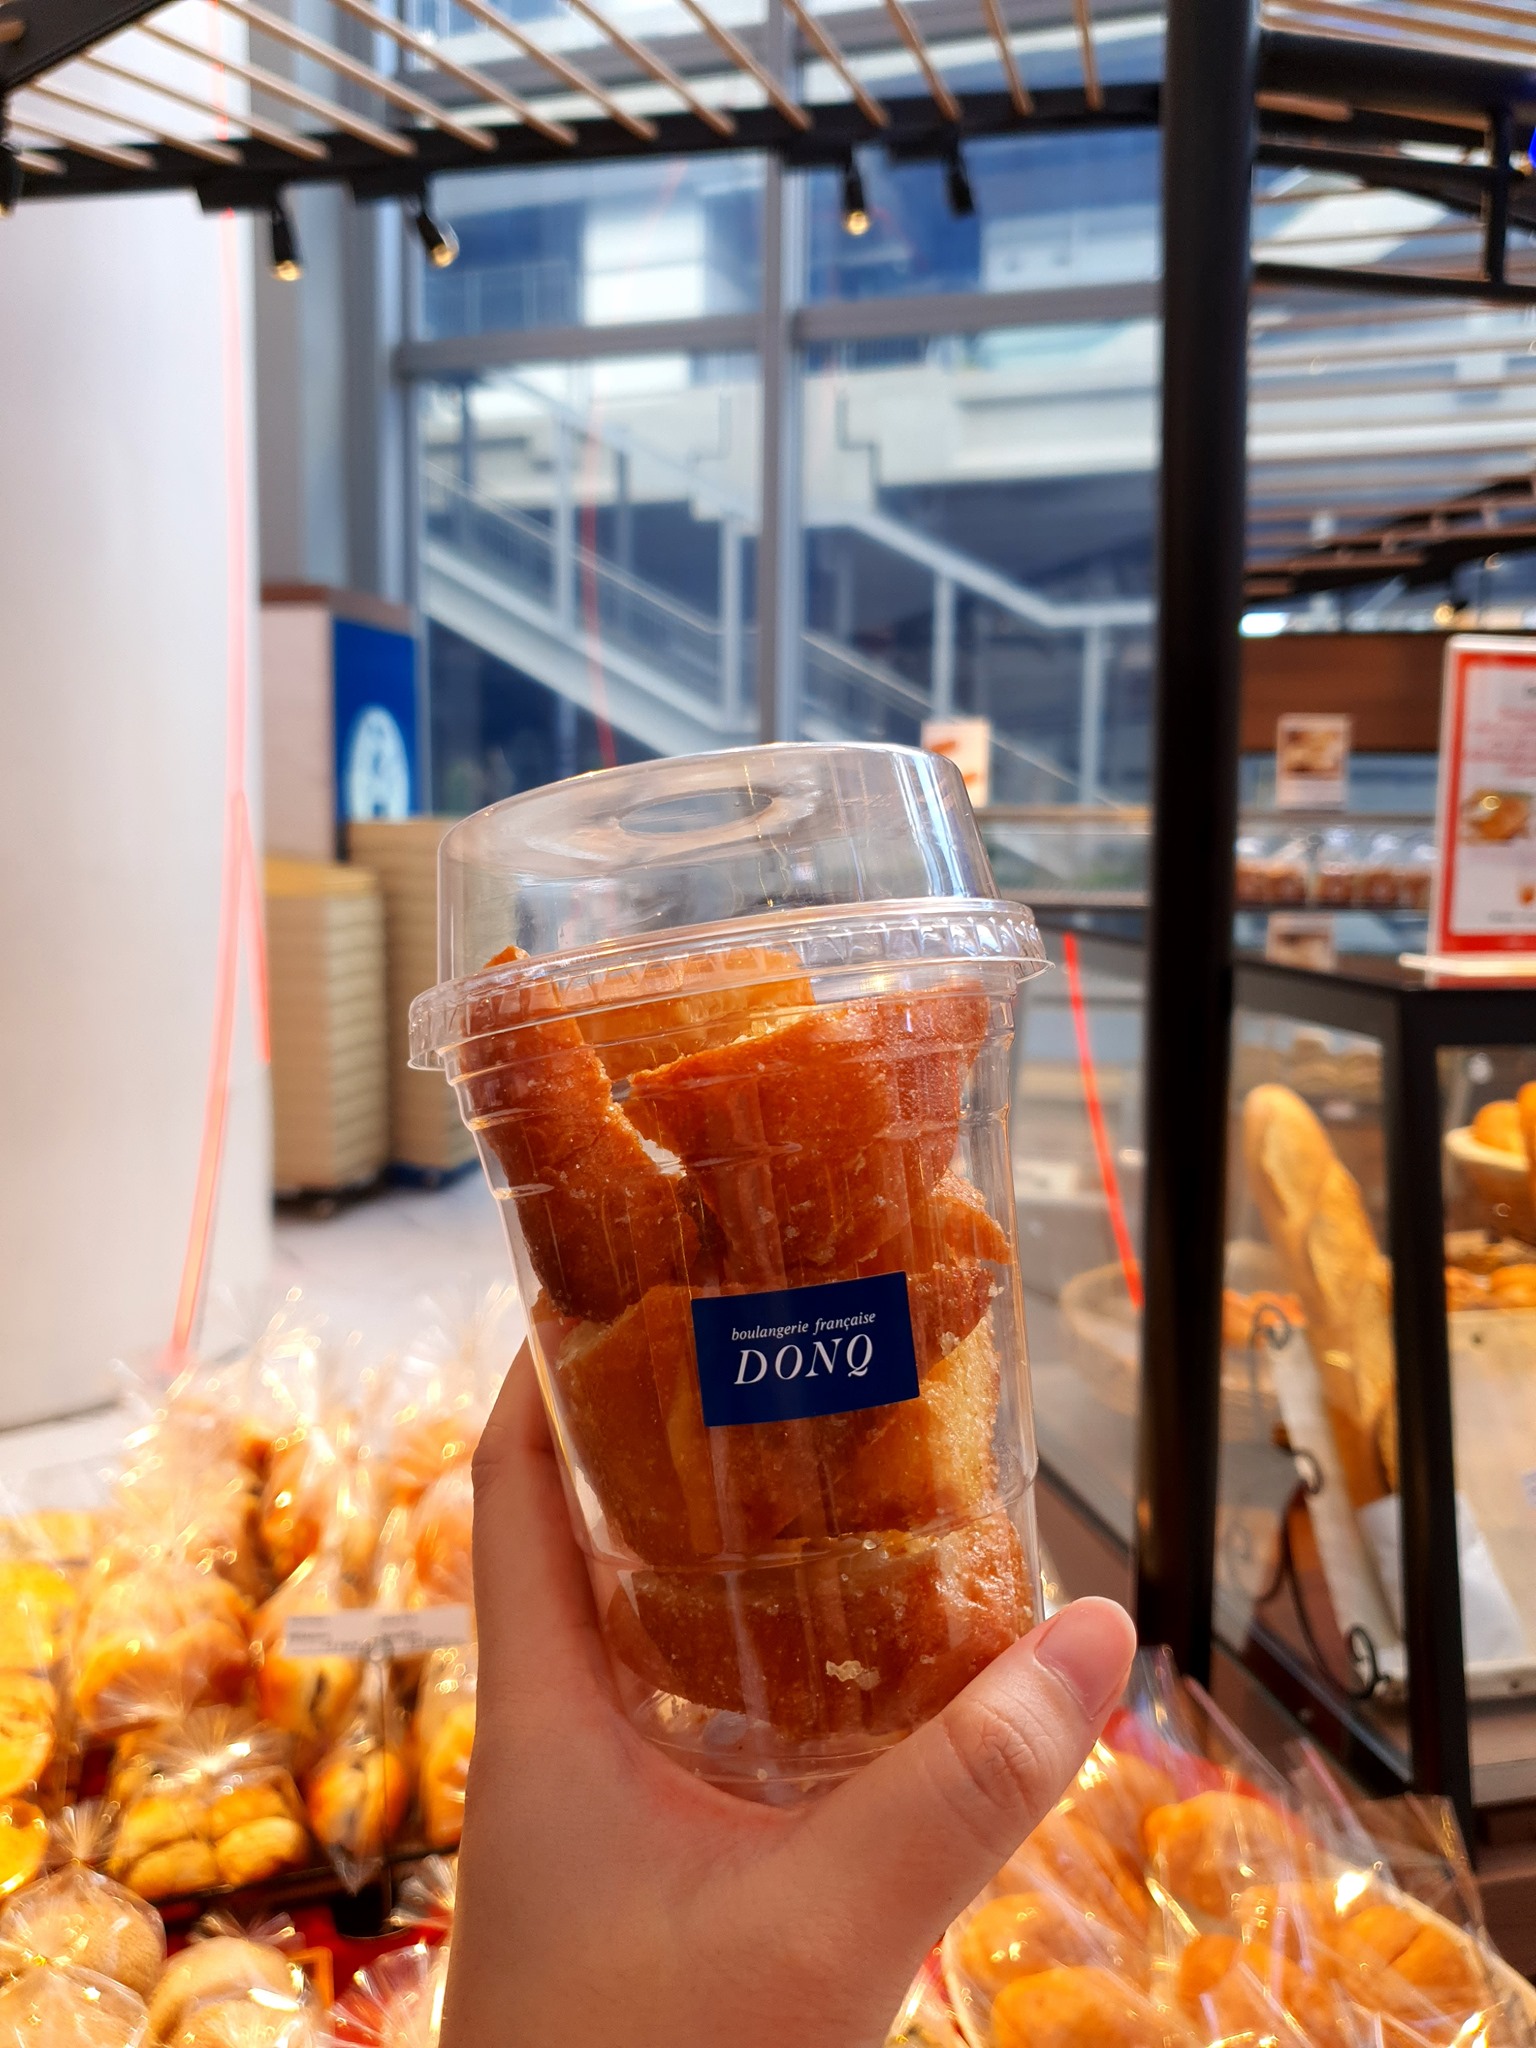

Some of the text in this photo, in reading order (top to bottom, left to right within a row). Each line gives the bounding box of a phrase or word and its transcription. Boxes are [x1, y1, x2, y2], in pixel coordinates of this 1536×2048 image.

[731, 1311, 876, 1341] boulangerie française
[734, 1333, 873, 1385] DONQ
